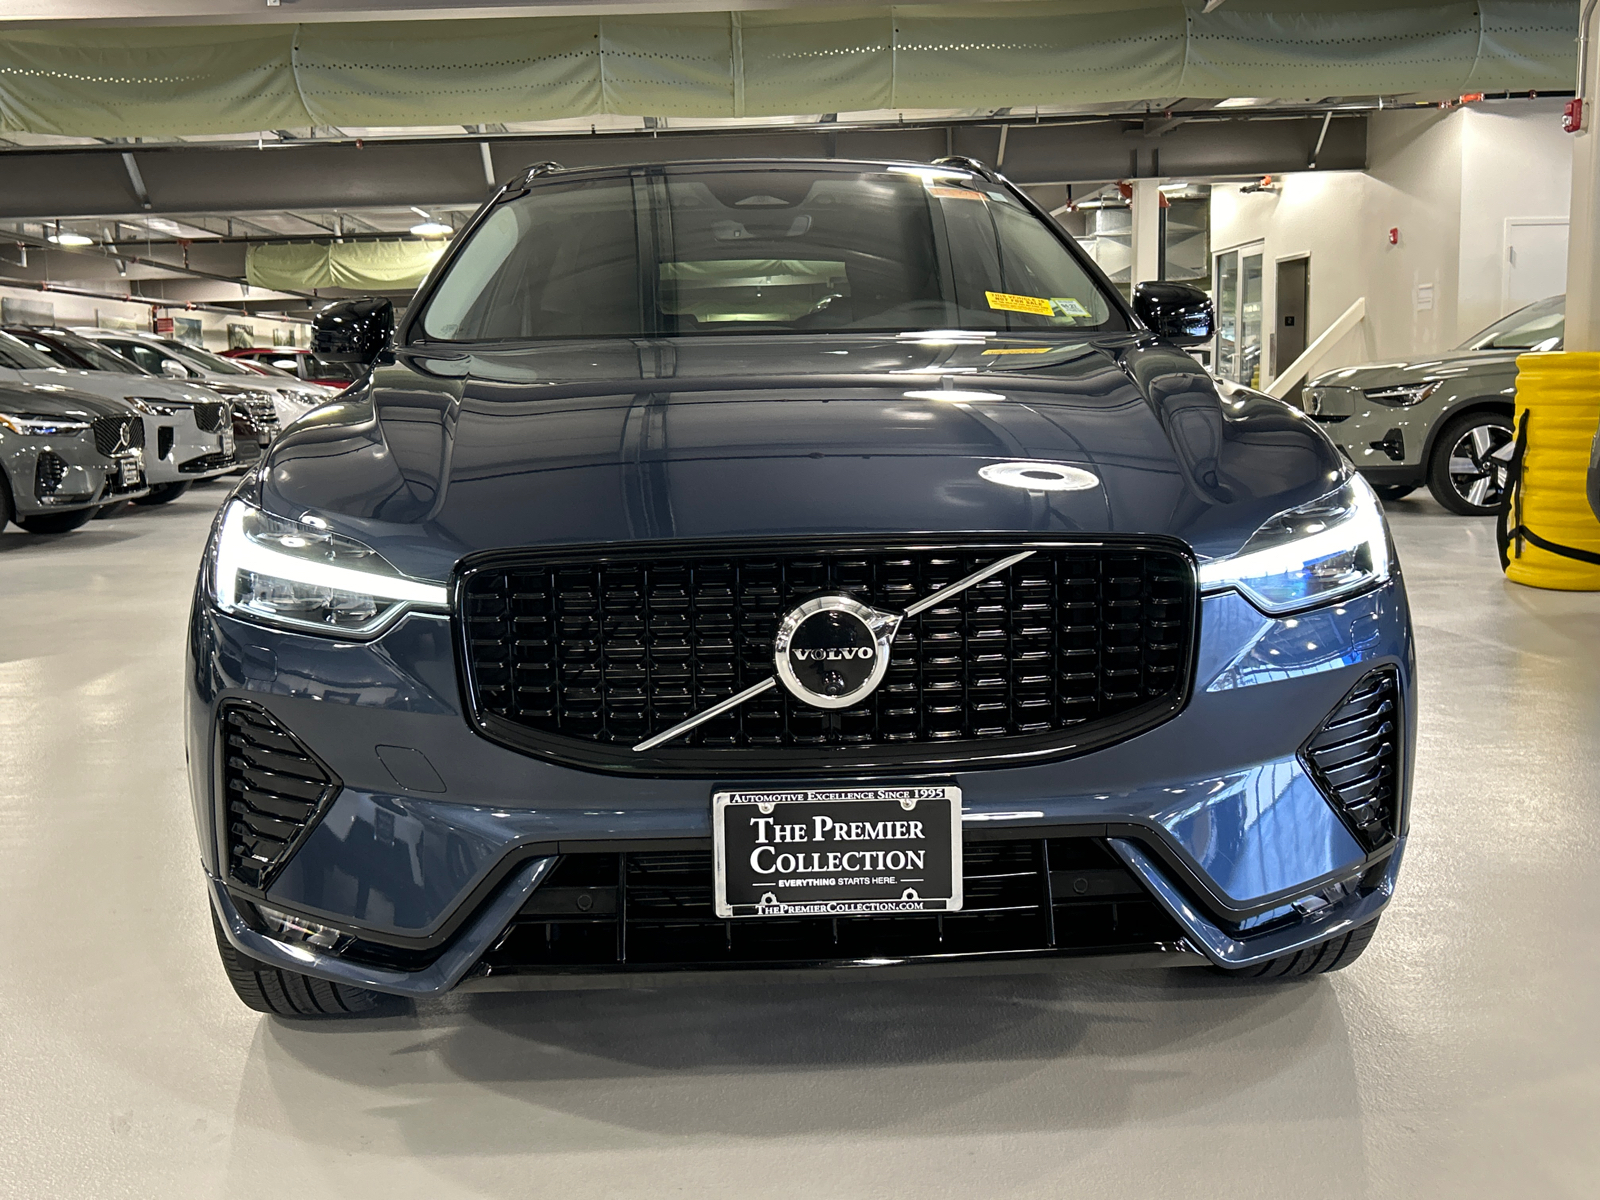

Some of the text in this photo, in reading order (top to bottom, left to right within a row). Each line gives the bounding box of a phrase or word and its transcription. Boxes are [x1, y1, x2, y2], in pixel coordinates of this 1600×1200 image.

[792, 647, 873, 661] VOLVO
[731, 788, 943, 803] AUTOMOTIVE EXCELLENCE SINCE 1995
[750, 816, 925, 843] THE PREMIER
[750, 846, 926, 874] COLLECTION
[778, 876, 898, 887] EVERYTHING STARTS HERE.
